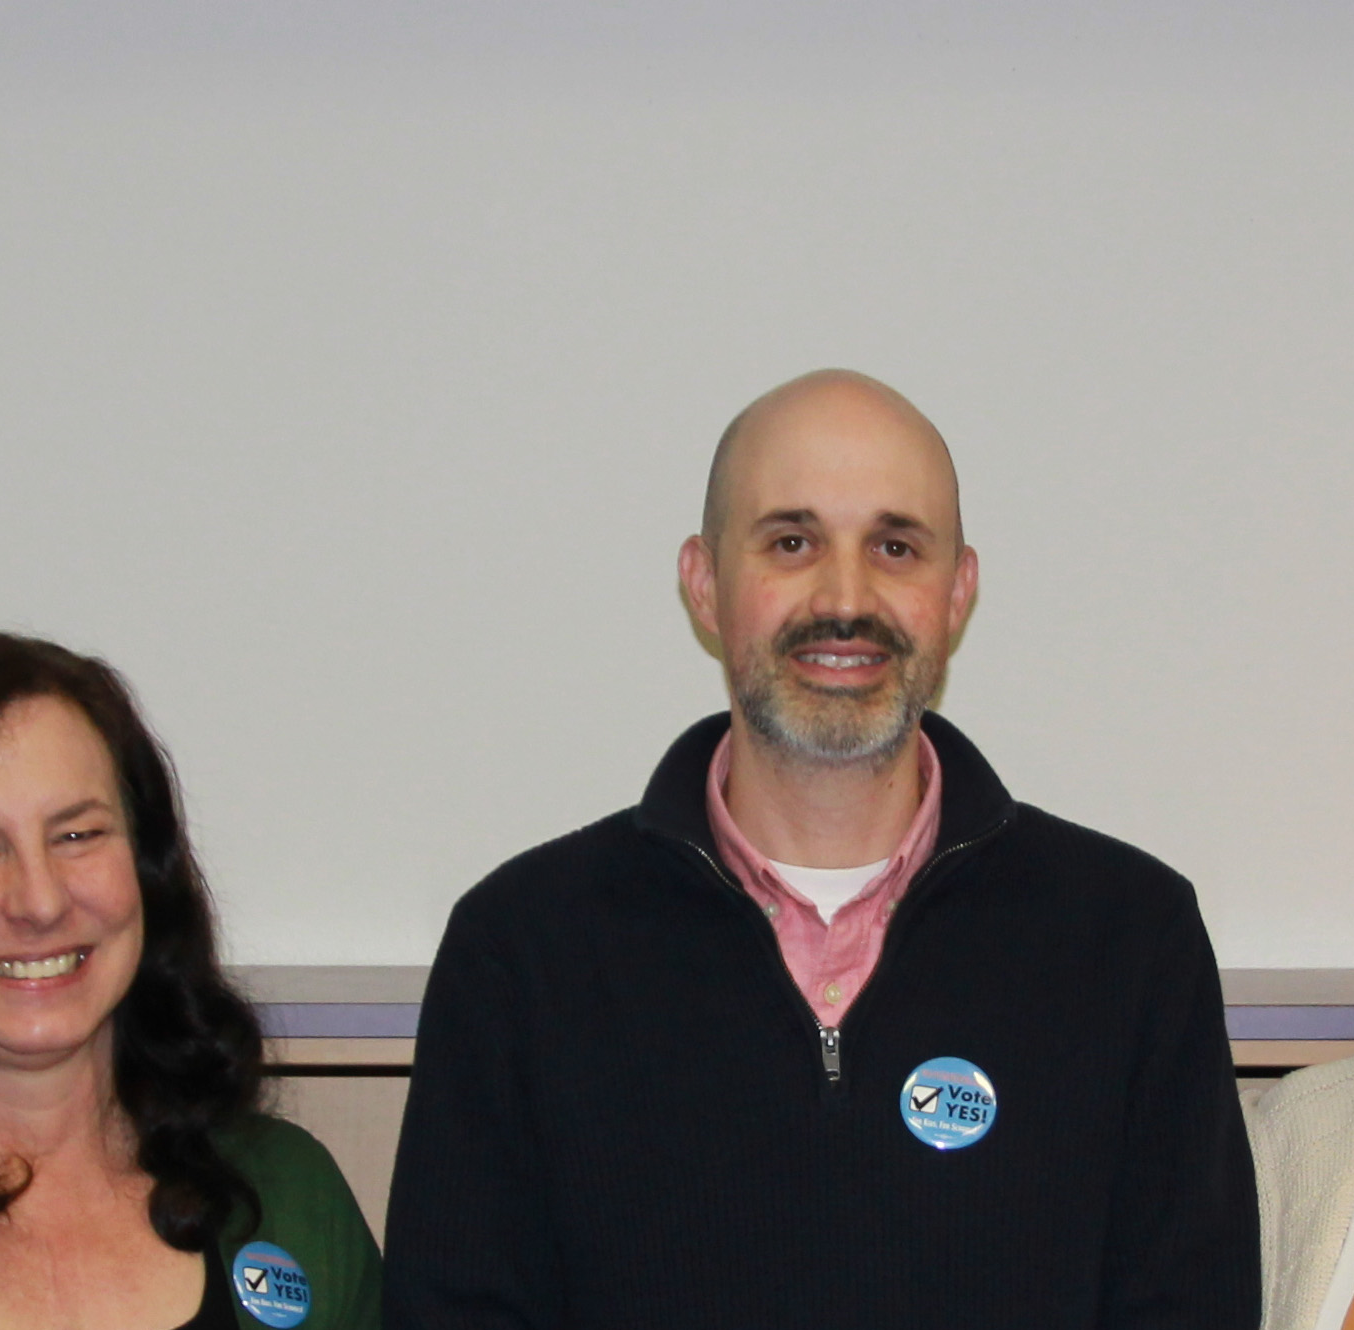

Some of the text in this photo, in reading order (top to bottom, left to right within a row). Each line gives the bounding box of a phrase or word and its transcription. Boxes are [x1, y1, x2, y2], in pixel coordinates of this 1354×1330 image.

[948, 1084, 992, 1105] Vote
[946, 1102, 987, 1124] YES!
[270, 1266, 308, 1286] Vote
[273, 1282, 309, 1303] YES!
